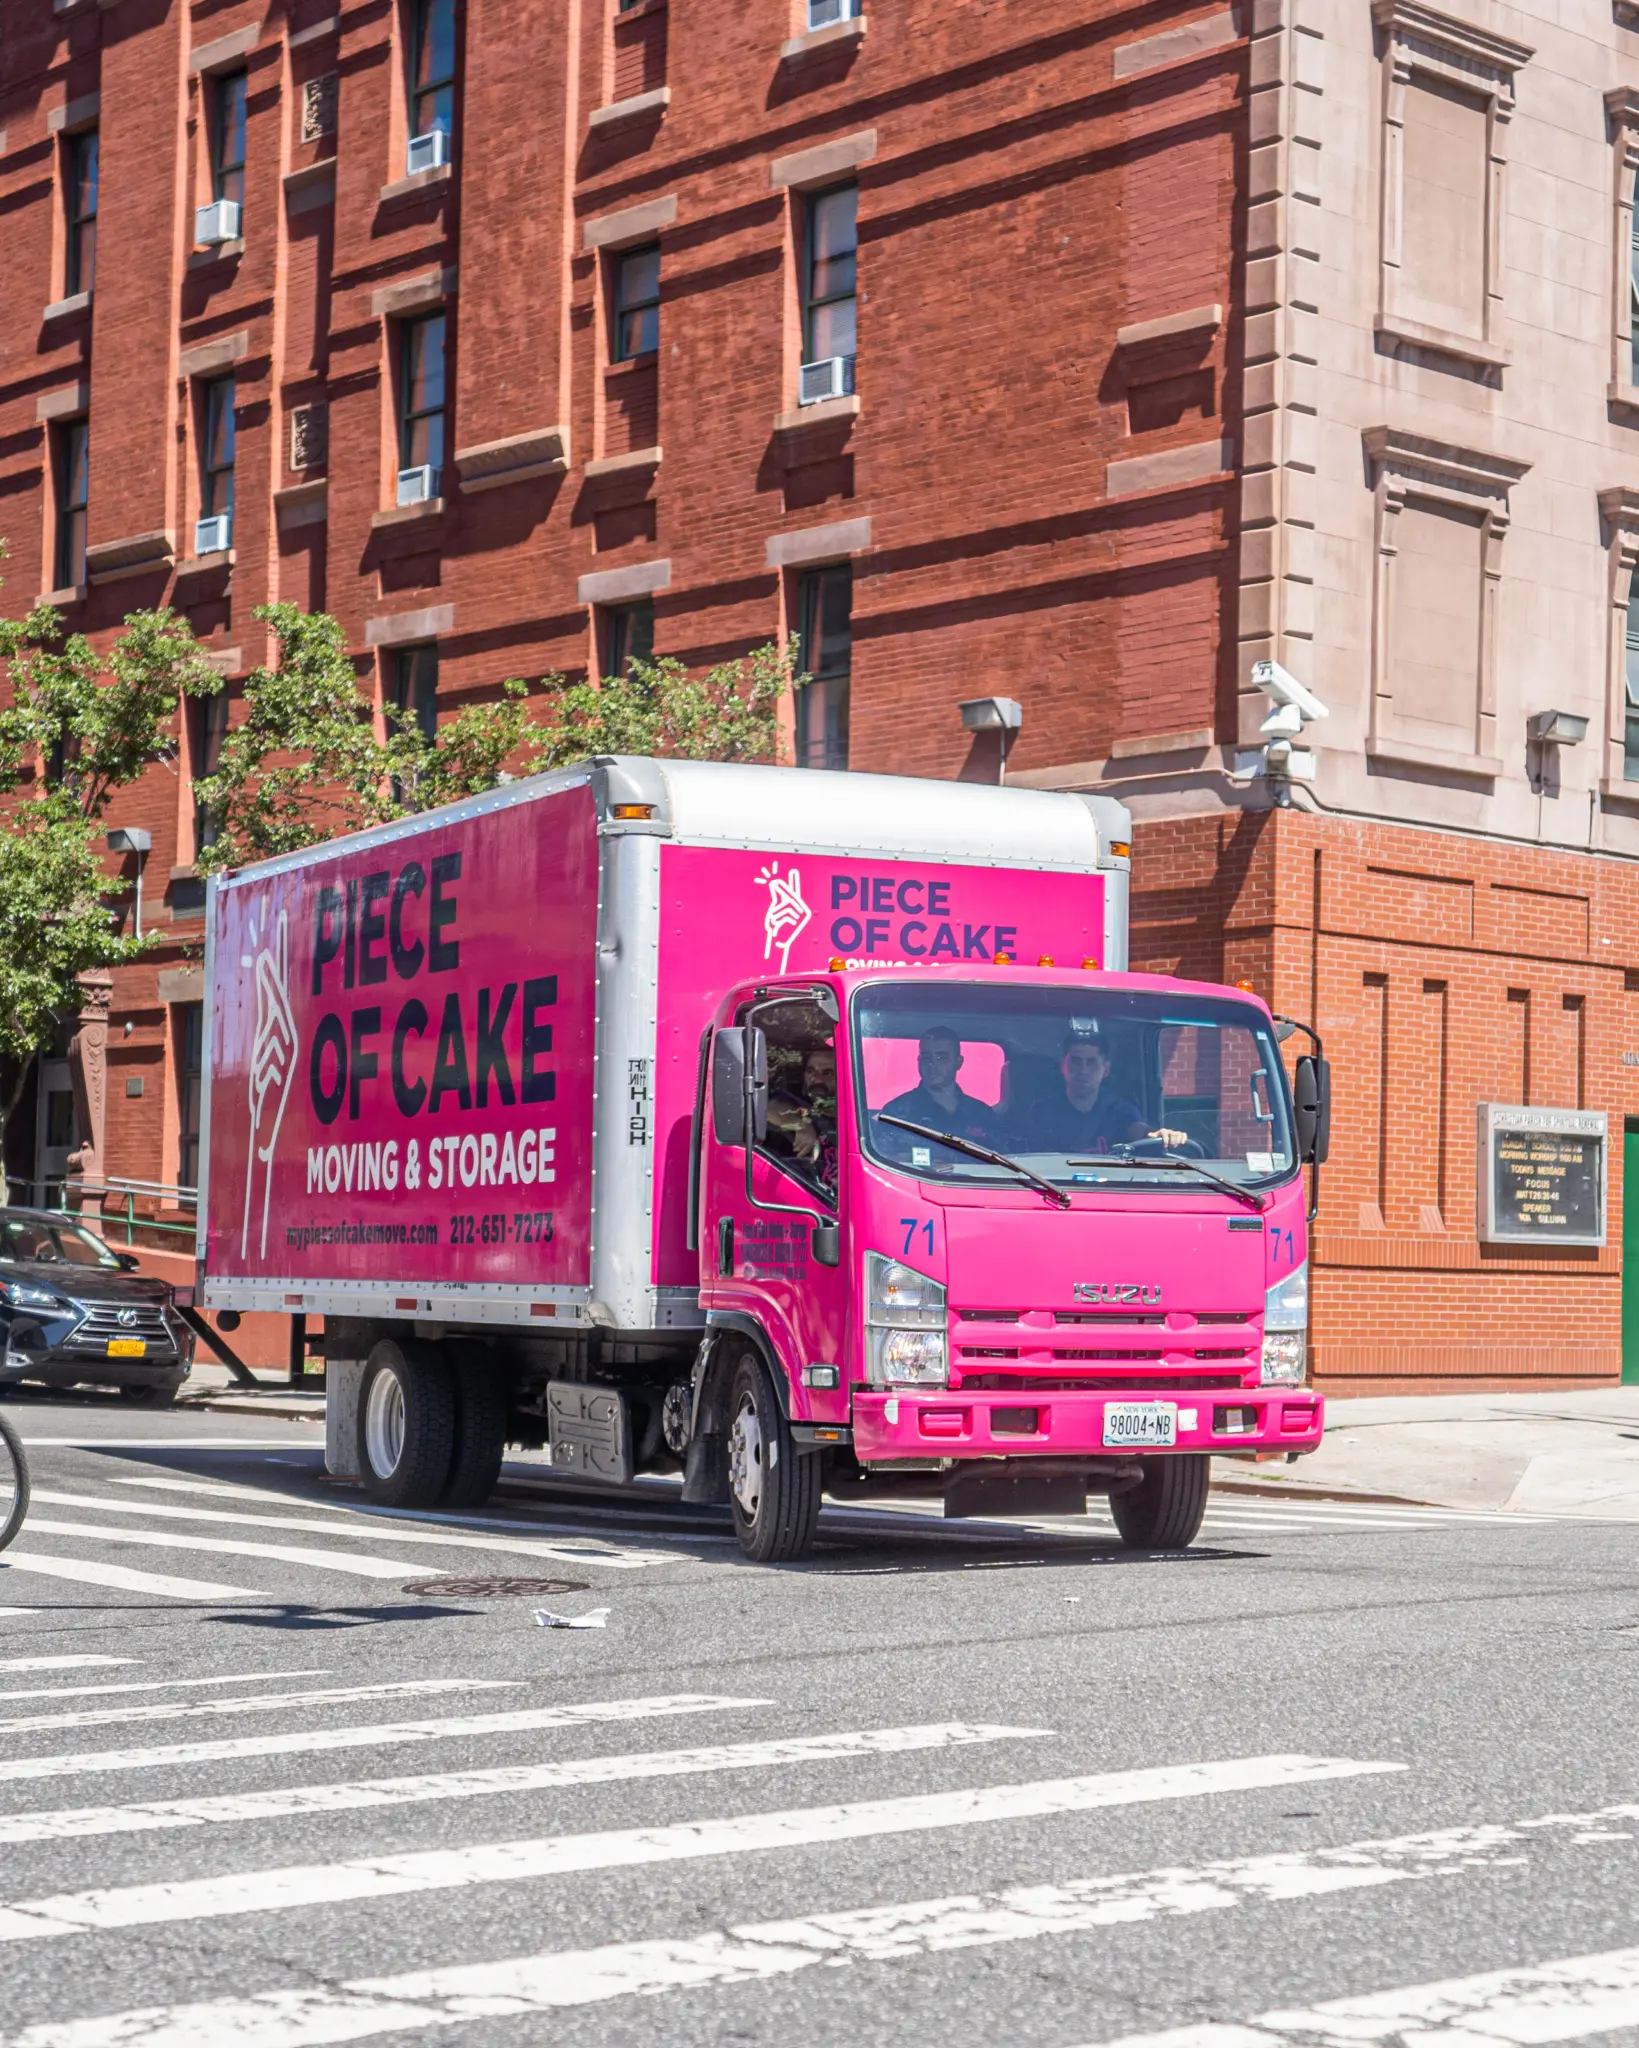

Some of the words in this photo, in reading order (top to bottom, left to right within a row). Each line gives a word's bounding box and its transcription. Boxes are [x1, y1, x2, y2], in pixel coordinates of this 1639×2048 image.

[831, 875, 951, 917] PIECE
[312, 853, 462, 996] PIECE
[830, 916, 890, 953] OF
[899, 920, 1017, 960] CAKE
[310, 1006, 382, 1126] OF
[391, 975, 558, 1118] CAKE
[307, 1135, 399, 1195] MOVING
[404, 1140, 421, 1190] &
[428, 1128, 557, 1189] STORAGE
[1499, 1150, 1528, 1160] MORNING
[1537, 1165, 1566, 1177] MESSAGE
[1525, 1179, 1550, 1189] FOCUS
[1522, 1203, 1552, 1213] SPEAKER
[450, 1212, 554, 1245] 212-651-7273
[900, 1218, 935, 1256] 71
[1270, 1228, 1294, 1265] 71
[1073, 1282, 1162, 1305] ISUZU
